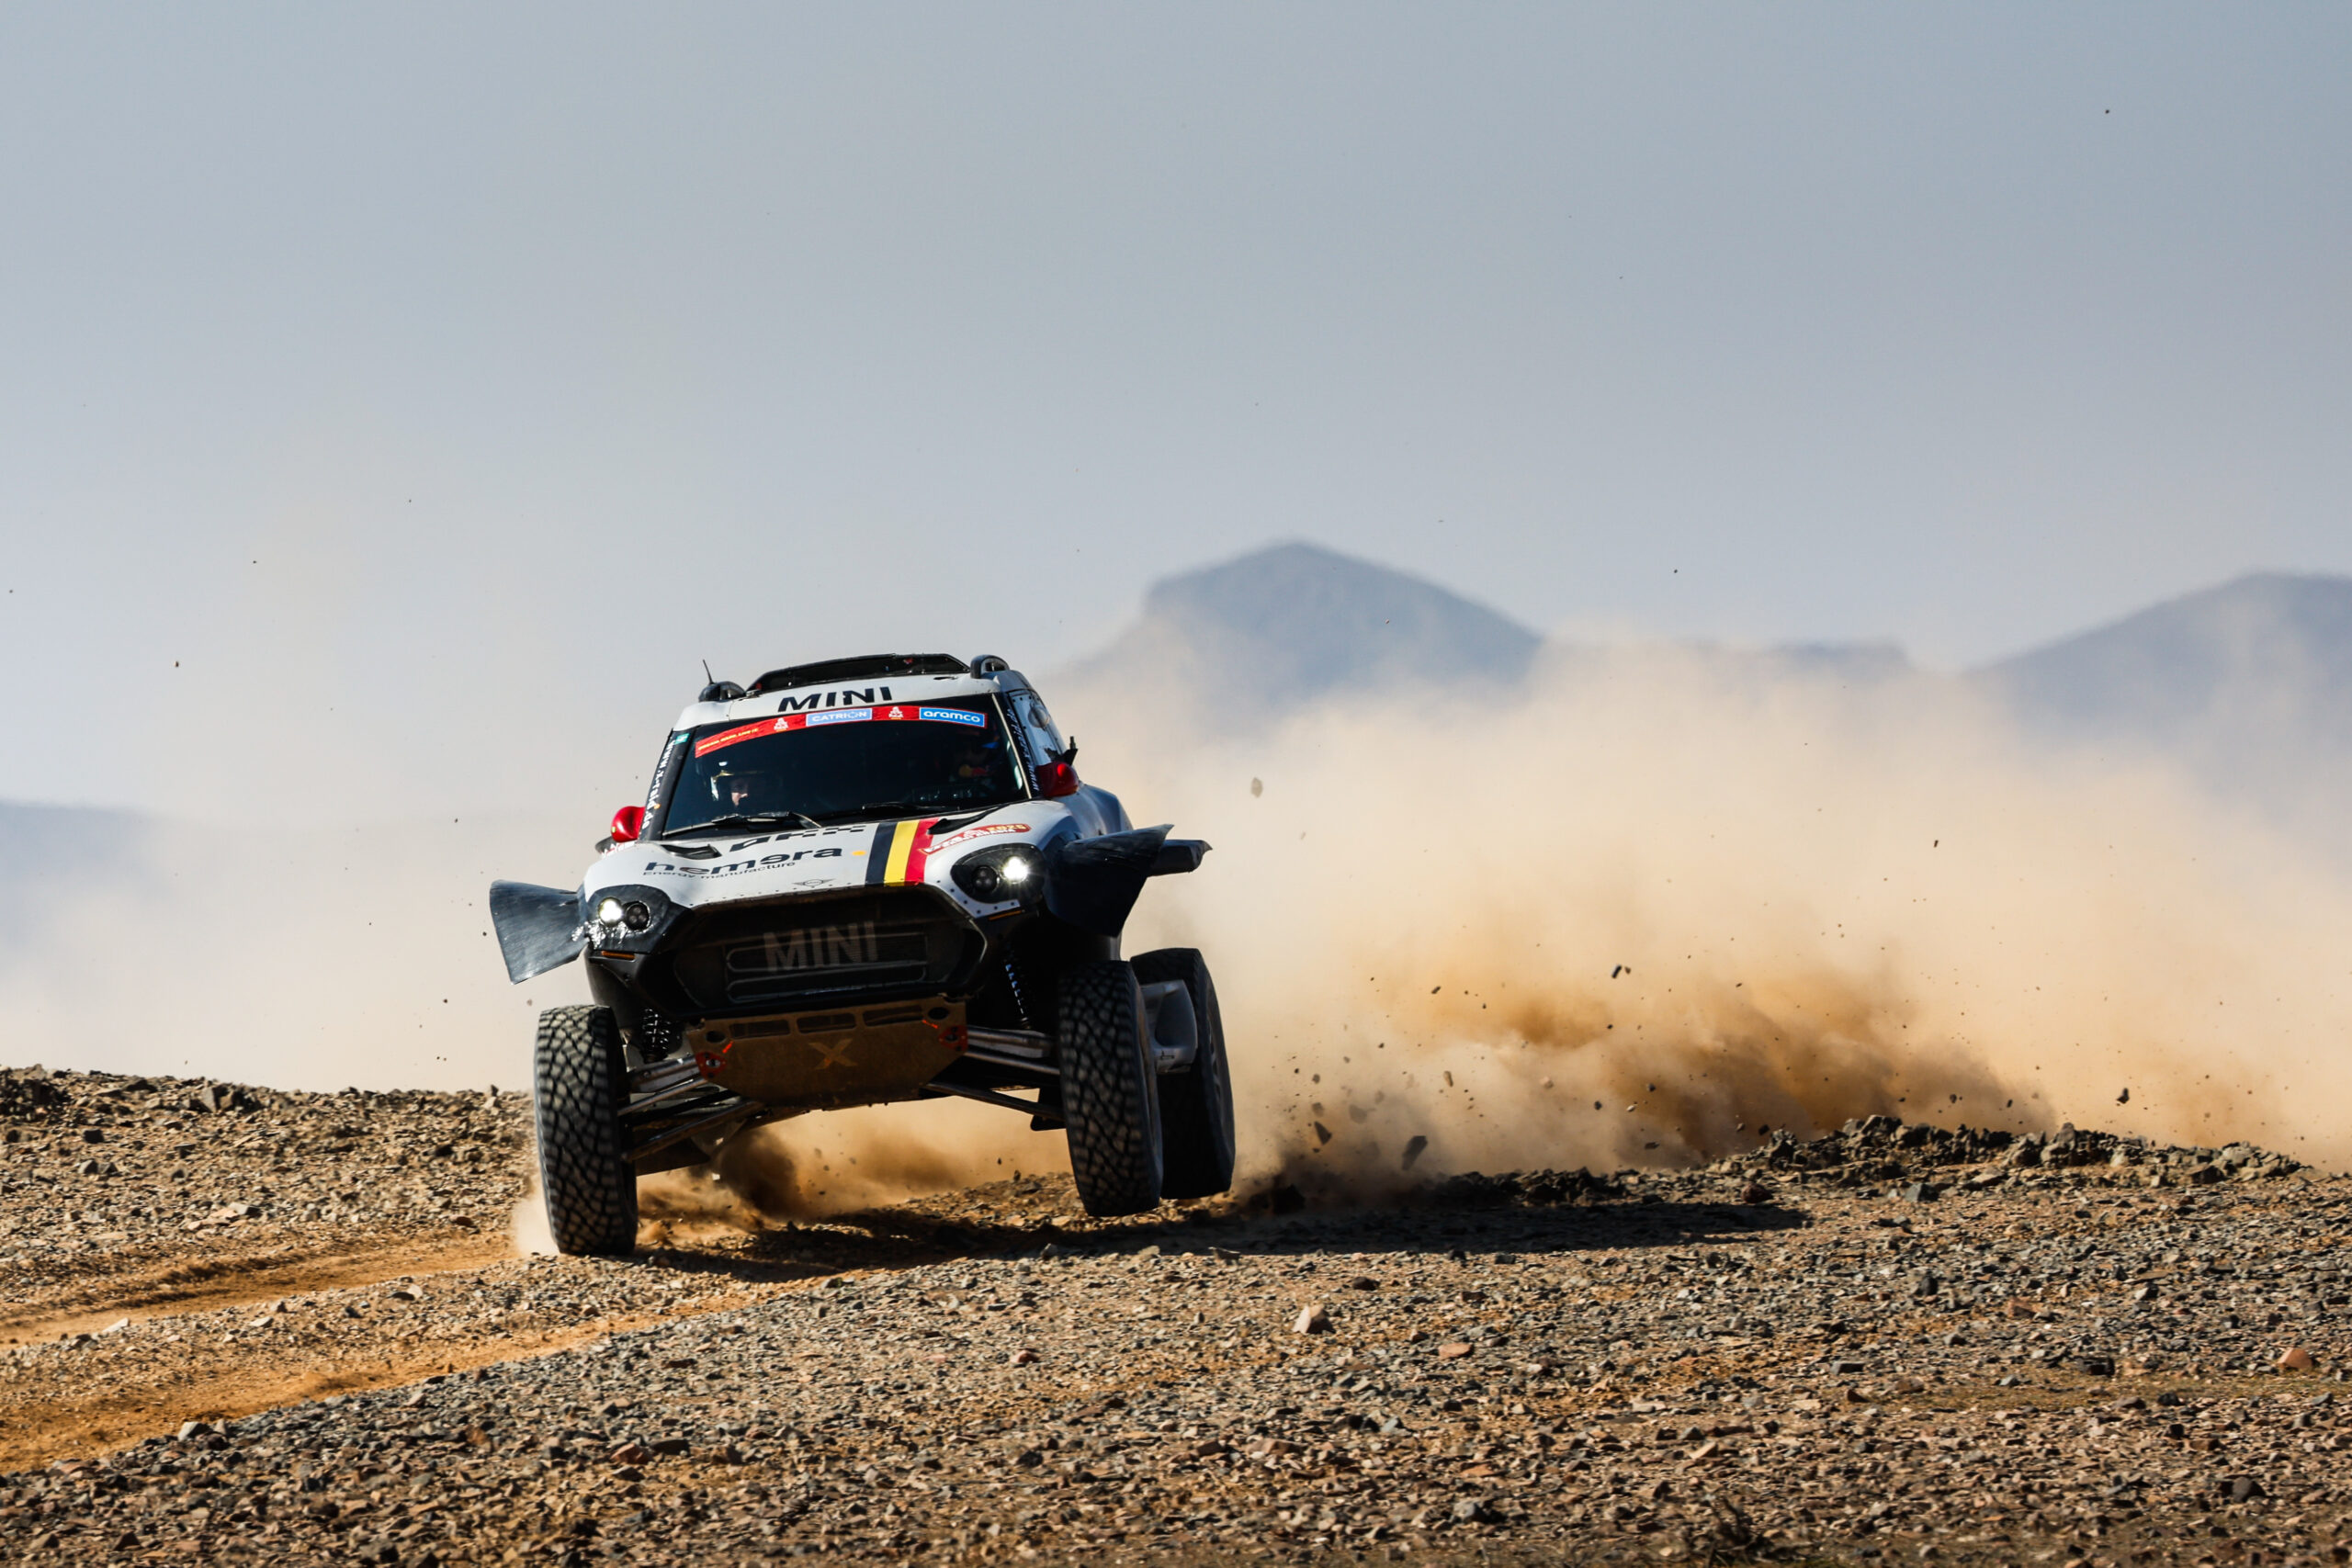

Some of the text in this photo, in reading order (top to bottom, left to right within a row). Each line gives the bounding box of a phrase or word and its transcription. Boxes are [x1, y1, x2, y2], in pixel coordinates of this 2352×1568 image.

[778, 686, 892, 712] MINI
[812, 711, 867, 722] CATRION
[923, 710, 980, 723] aramco
[645, 847, 842, 875] hemera
[701, 862, 796, 879] manufacture
[763, 921, 877, 972] MINI
